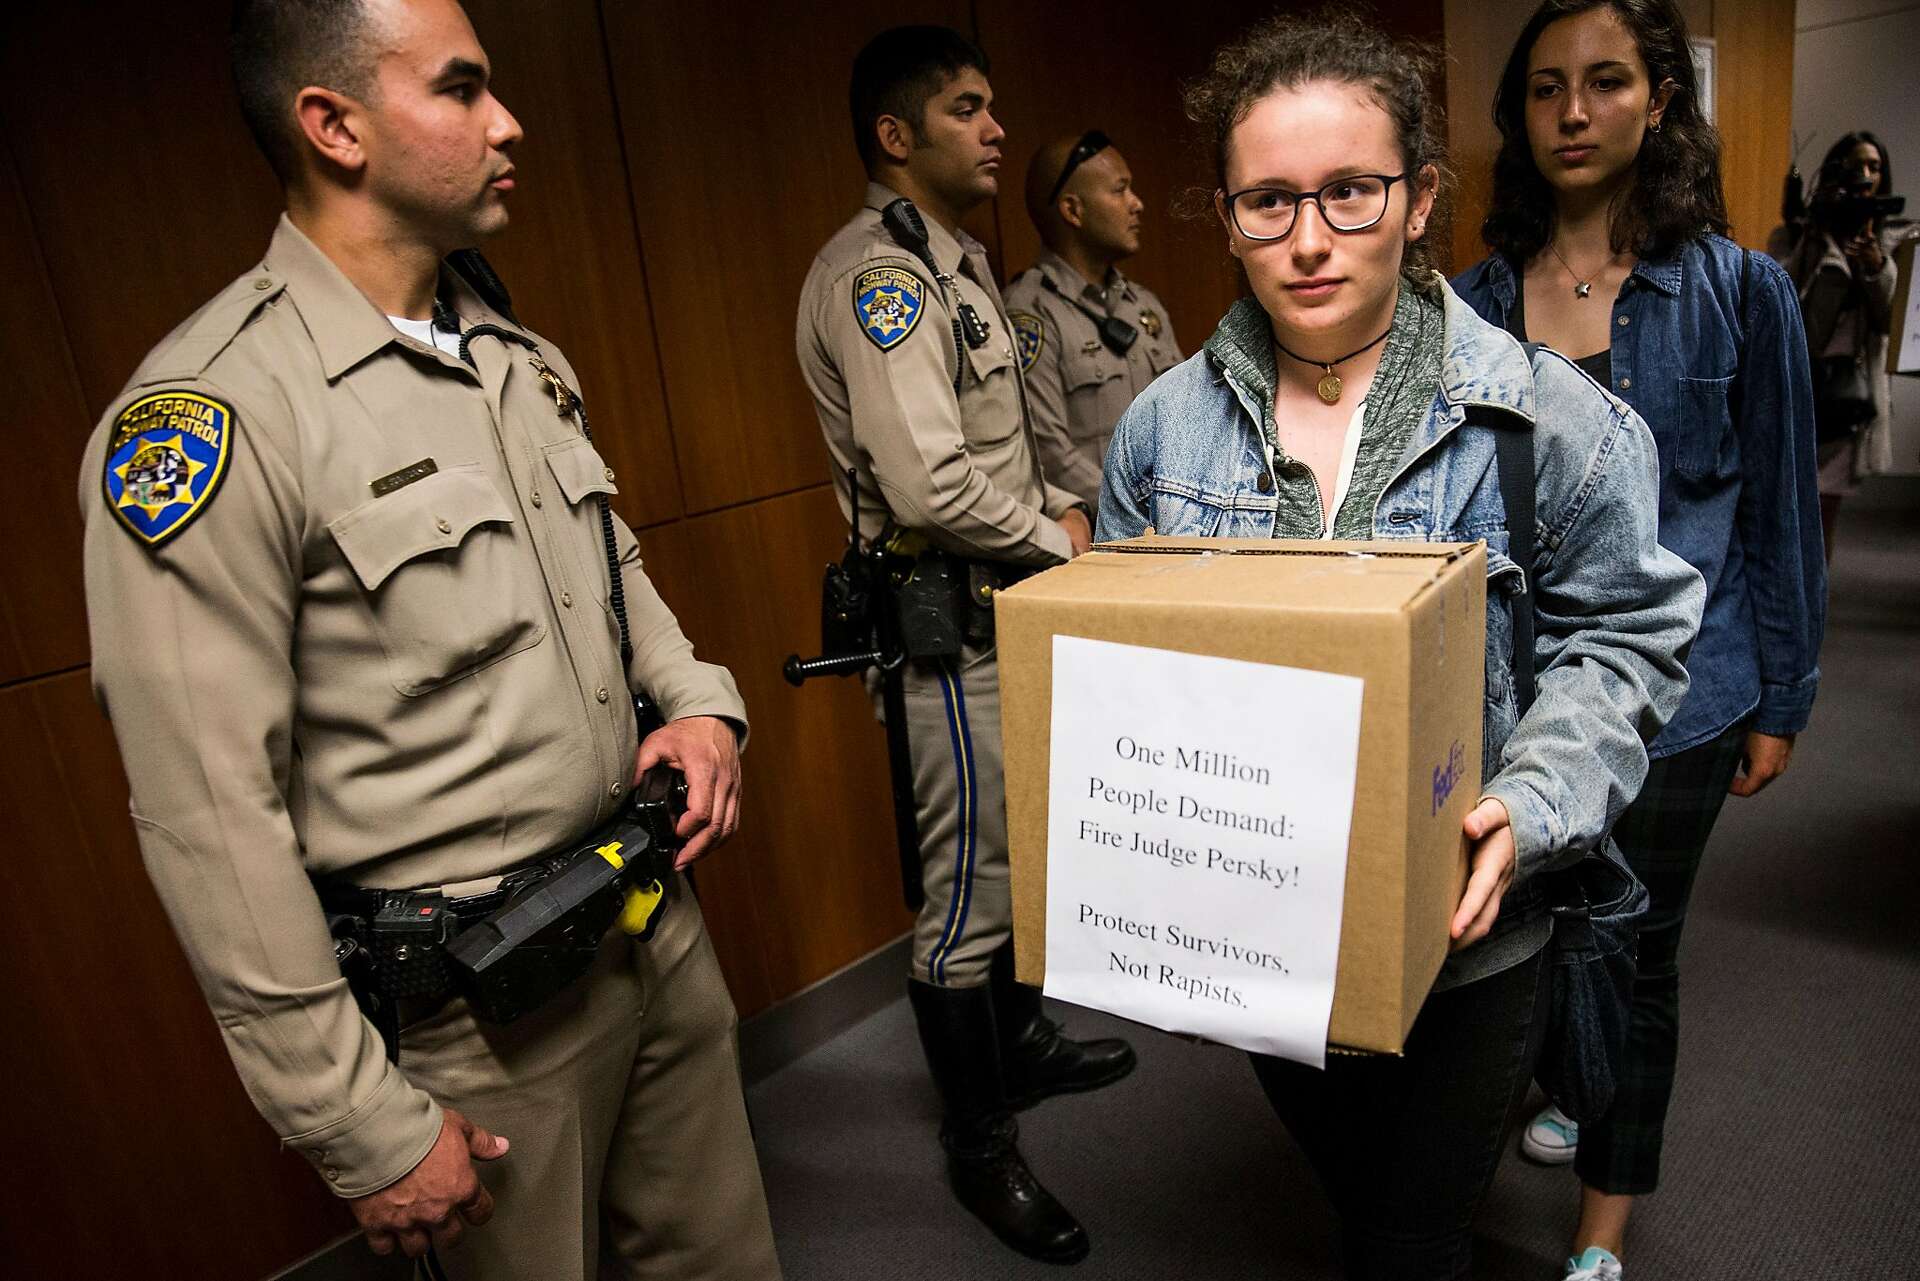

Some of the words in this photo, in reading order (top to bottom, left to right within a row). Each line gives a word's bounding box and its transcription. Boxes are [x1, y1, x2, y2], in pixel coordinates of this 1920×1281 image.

[863, 271, 917, 290] CALIFORNIA
[893, 280, 920, 302] PATROL
[168, 414, 220, 449] PATROL
[1116, 736, 1165, 767] One
[1175, 746, 1270, 786] Million
[1088, 776, 1169, 815] People
[1177, 795, 1295, 840] Demand:
[1079, 819, 1123, 849] Fire
[1129, 831, 1198, 869] Judge
[1206, 847, 1300, 890] Persky!
[1078, 903, 1158, 942] Protect
[1108, 951, 1151, 981] Not
[1157, 963, 1248, 1009] Rapists.
